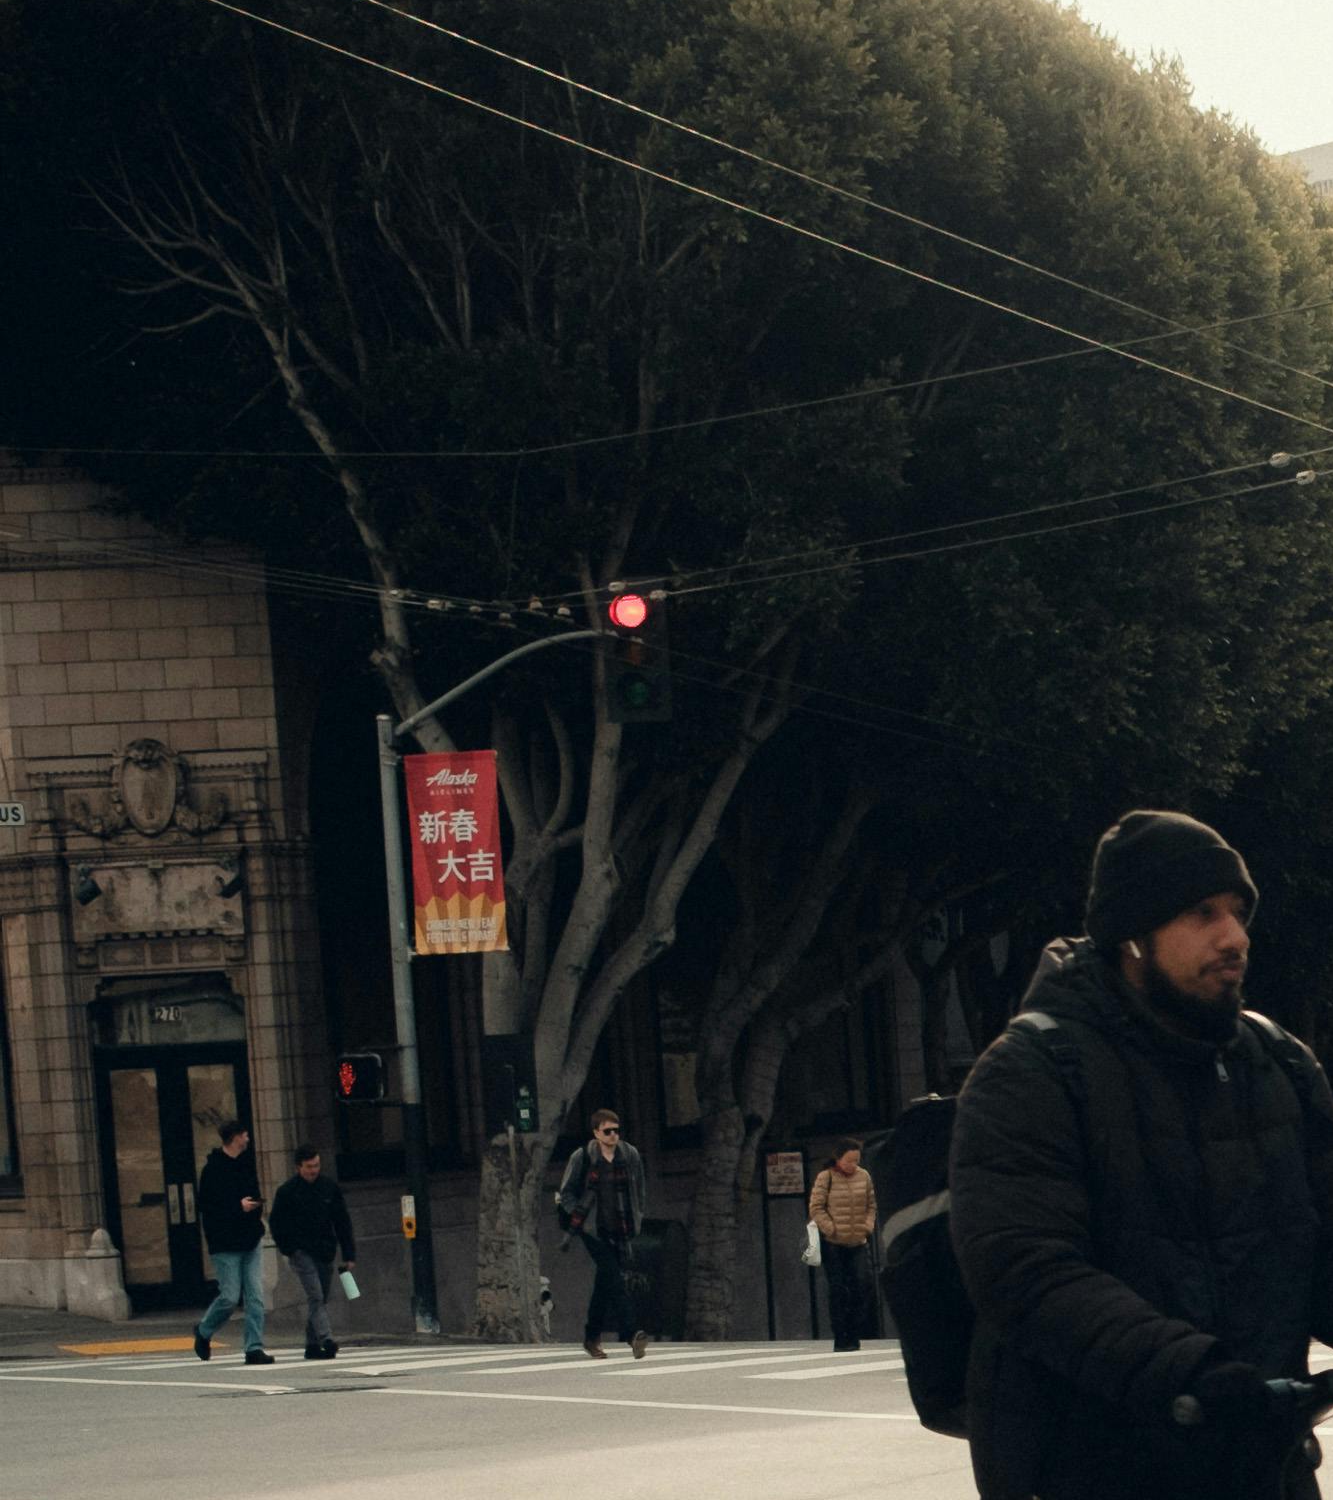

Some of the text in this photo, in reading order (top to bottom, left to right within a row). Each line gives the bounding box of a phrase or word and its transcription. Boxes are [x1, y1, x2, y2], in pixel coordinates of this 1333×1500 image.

[426, 768, 478, 787] Alaska
[418, 809, 478, 844] 新春
[437, 849, 496, 884] 大吉
